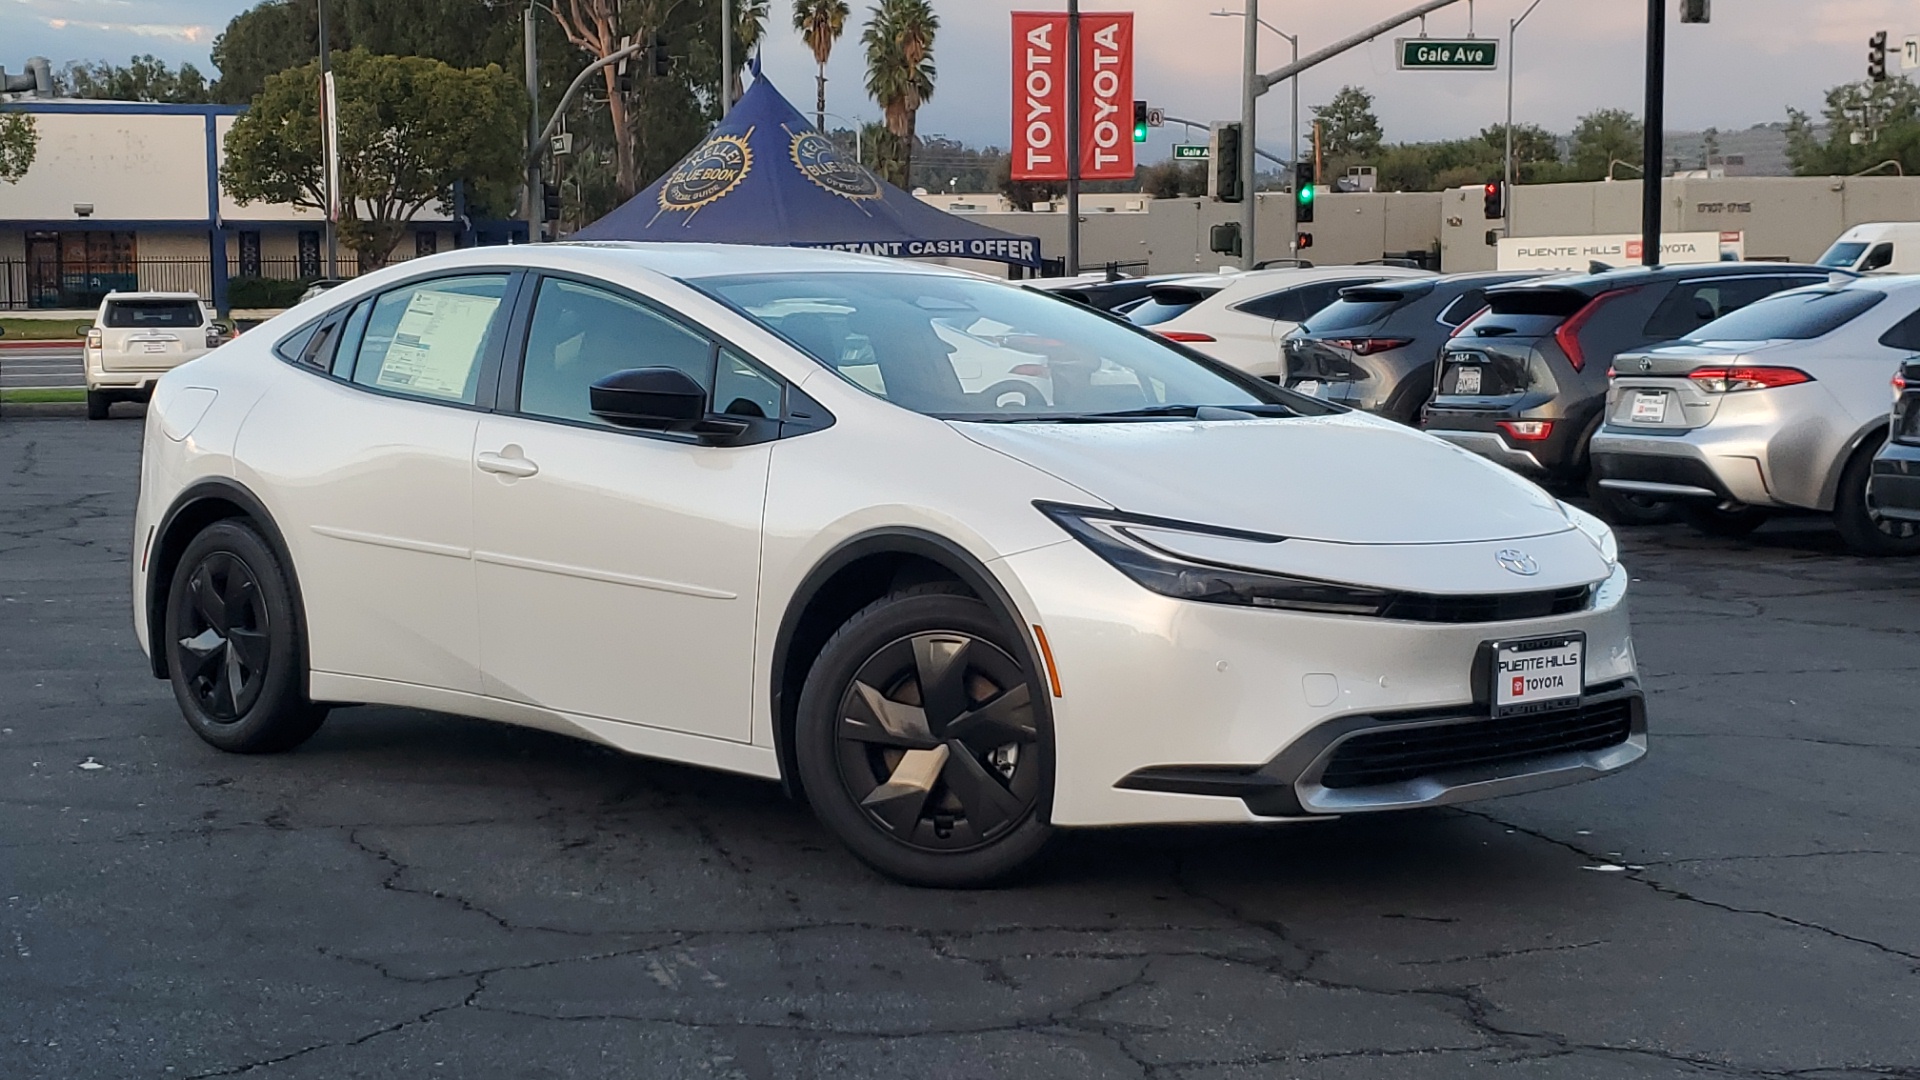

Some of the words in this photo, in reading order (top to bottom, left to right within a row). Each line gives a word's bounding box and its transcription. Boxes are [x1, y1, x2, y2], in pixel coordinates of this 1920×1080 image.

[1418, 47, 1450, 61] Gale
[1454, 47, 1483, 61] Ave
[1027, 23, 1052, 170] TOYOTA
[1093, 23, 1119, 170] TOYOTA
[691, 145, 741, 165] KELLEY
[1183, 148, 1200, 156] Gale
[672, 169, 703, 183] BLUE
[701, 168, 738, 181] BOOK
[909, 240, 964, 255] CASH
[970, 240, 1033, 261] OFFER
[1518, 247, 1577, 257] PUENTE
[1583, 246, 1621, 256] HILLS
[1498, 657, 1544, 673] PUENTE
[1546, 653, 1577, 668] HILLS
[1526, 675, 1563, 691] TOYOTA
